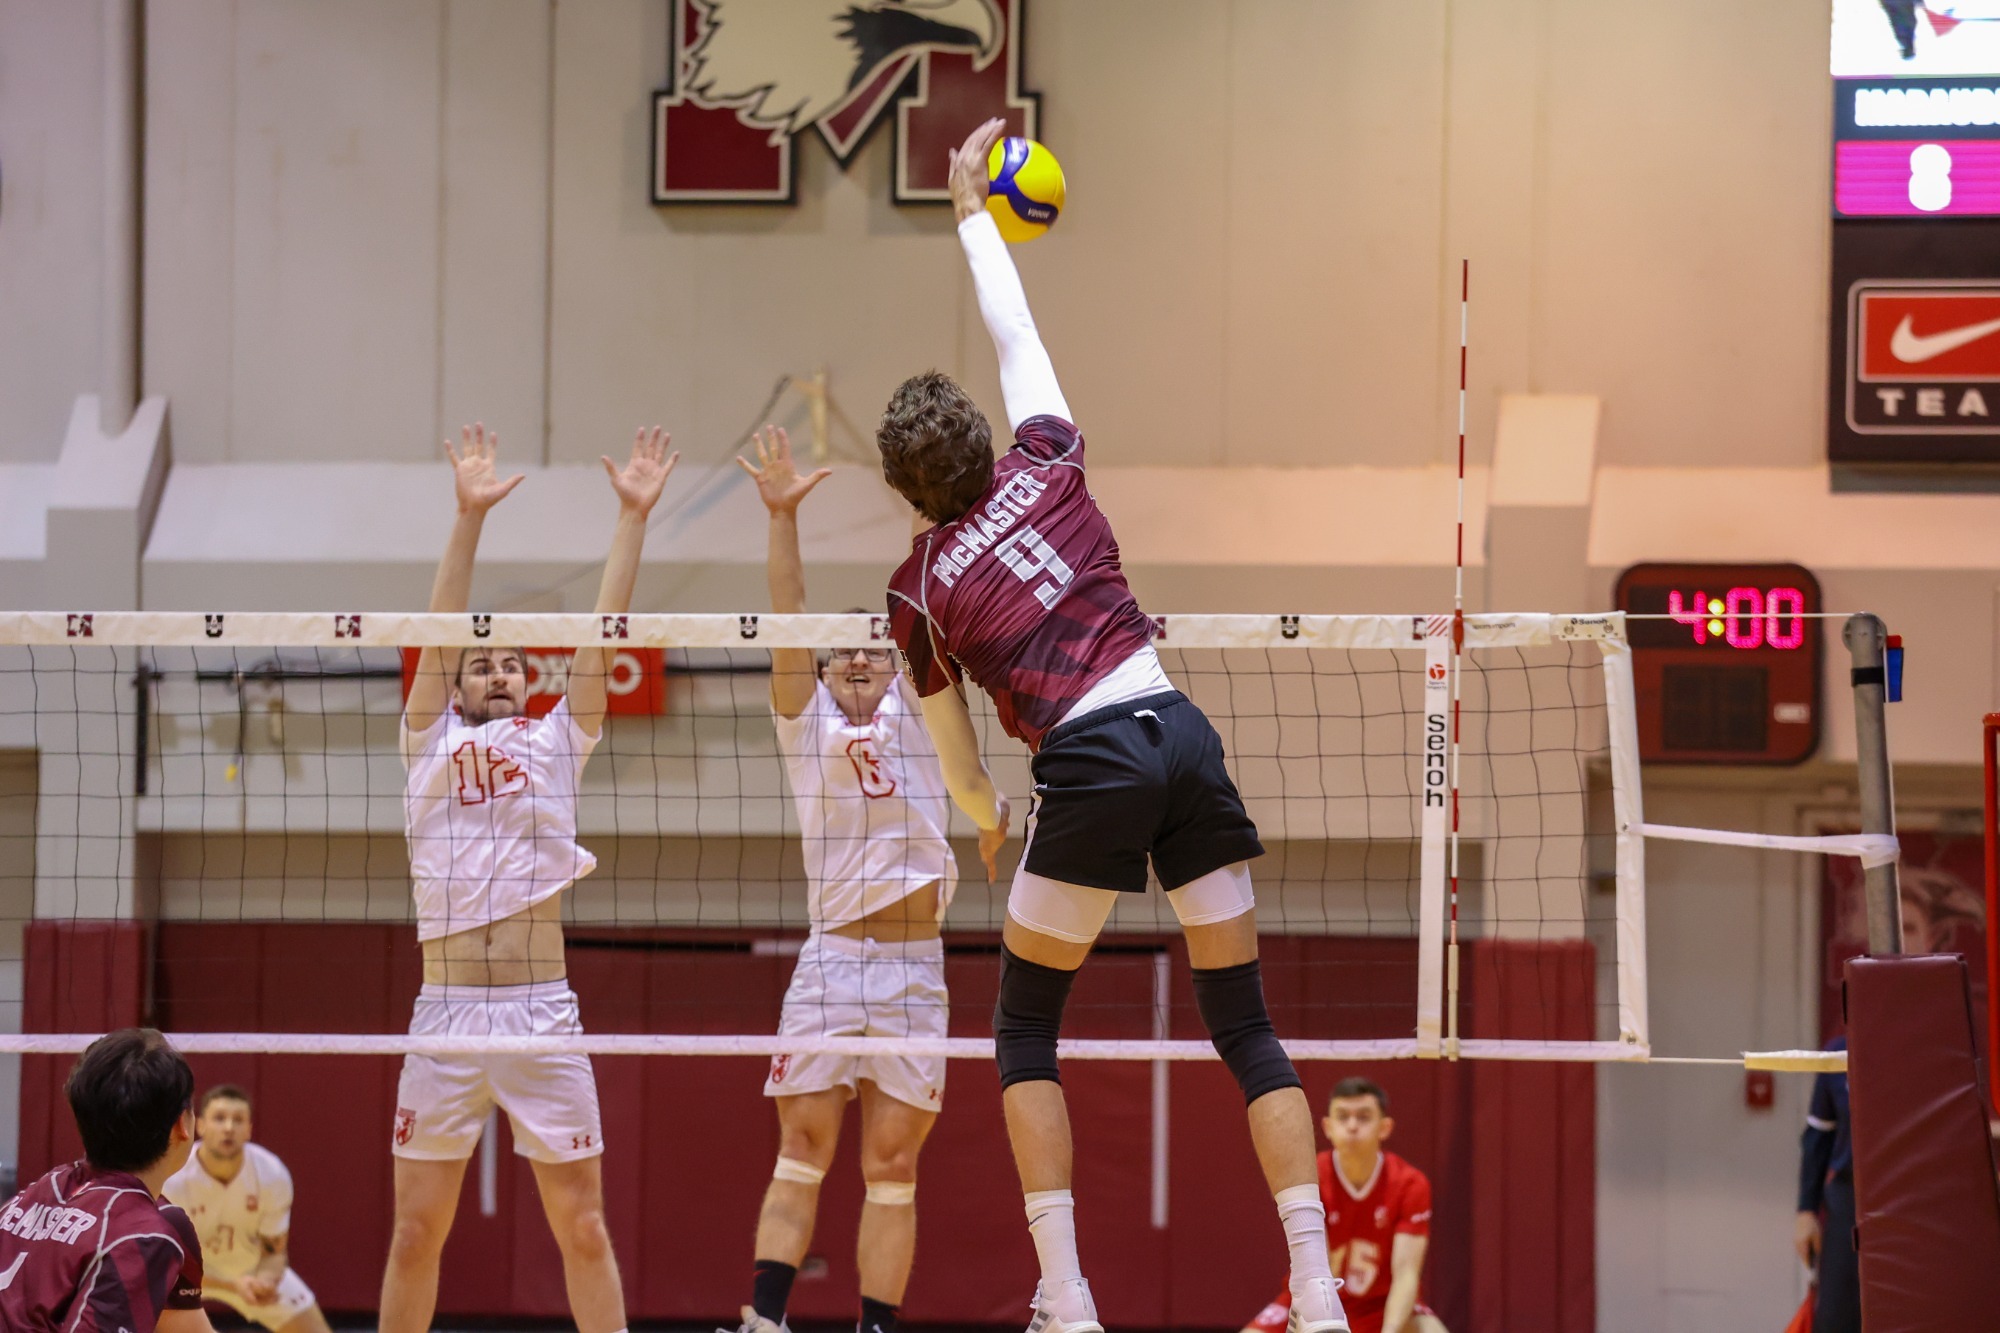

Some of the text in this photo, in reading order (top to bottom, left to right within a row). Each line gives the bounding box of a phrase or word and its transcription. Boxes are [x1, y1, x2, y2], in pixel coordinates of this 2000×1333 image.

[1875, 387, 1989, 417] TEA
[932, 471, 1048, 588] McMASTER
[994, 525, 1075, 610] 9
[1668, 586, 1804, 649] 4:00
[1425, 714, 1446, 807] Senoh
